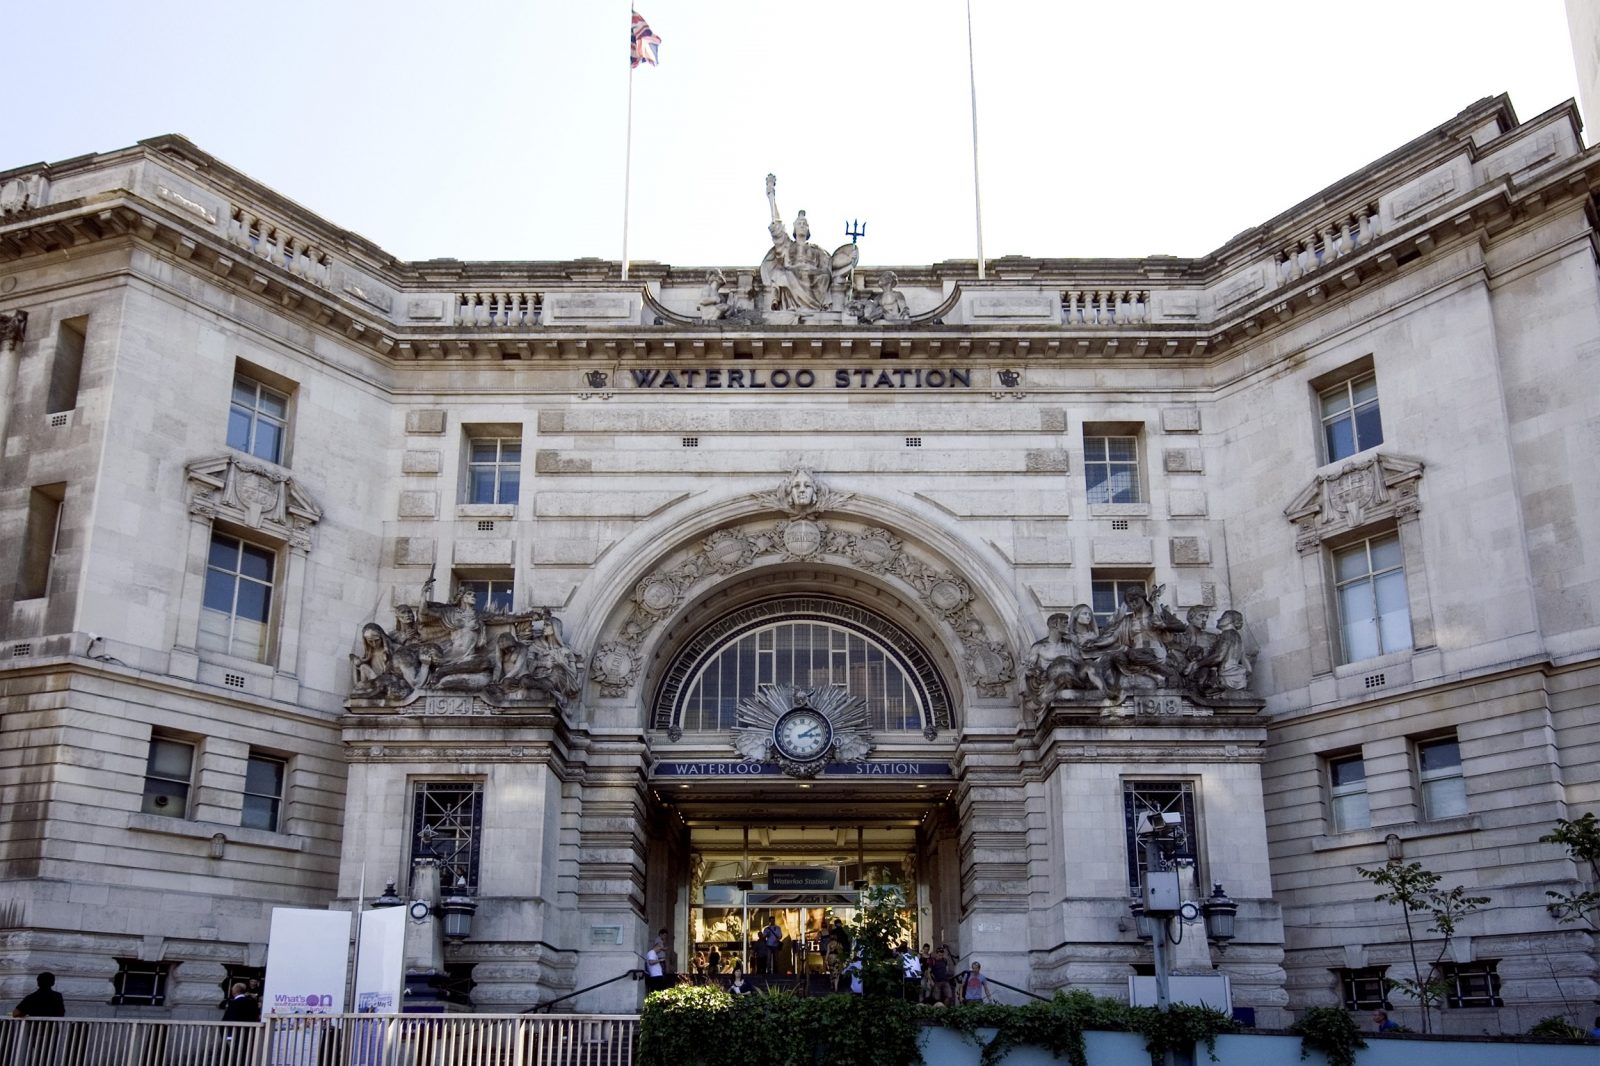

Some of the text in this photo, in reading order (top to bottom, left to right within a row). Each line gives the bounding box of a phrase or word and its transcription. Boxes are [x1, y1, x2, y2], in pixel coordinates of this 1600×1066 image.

[630, 368, 815, 388] WATERLOO
[835, 368, 972, 388] STATION
[793, 600, 815, 613] THE
[820, 600, 873, 626] COMPANY
[429, 699, 470, 714] 1914
[1138, 699, 1179, 714] 1918
[675, 763, 920, 775] WATERLOO STATION
[275, 994, 305, 1003] What's
